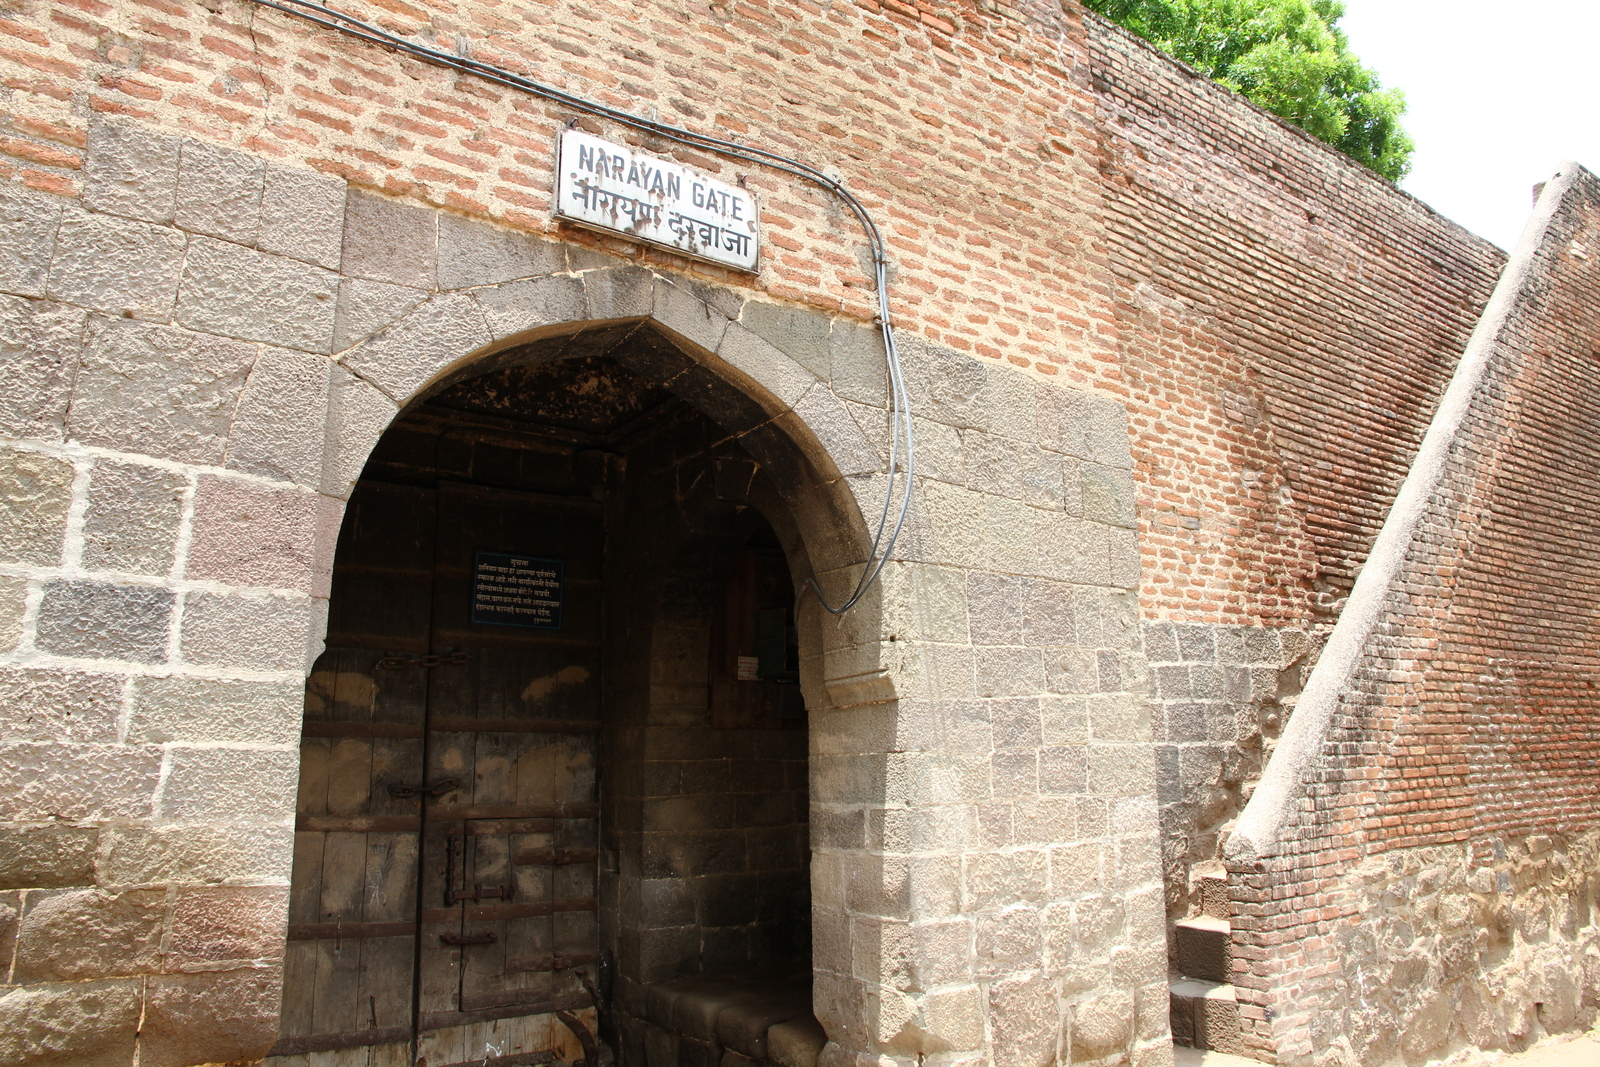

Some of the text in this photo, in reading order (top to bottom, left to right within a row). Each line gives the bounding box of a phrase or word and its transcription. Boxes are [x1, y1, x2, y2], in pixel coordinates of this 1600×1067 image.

[572, 179, 752, 258] नारायण दरवाजा
[579, 144, 743, 221] NARAYAN GATE
